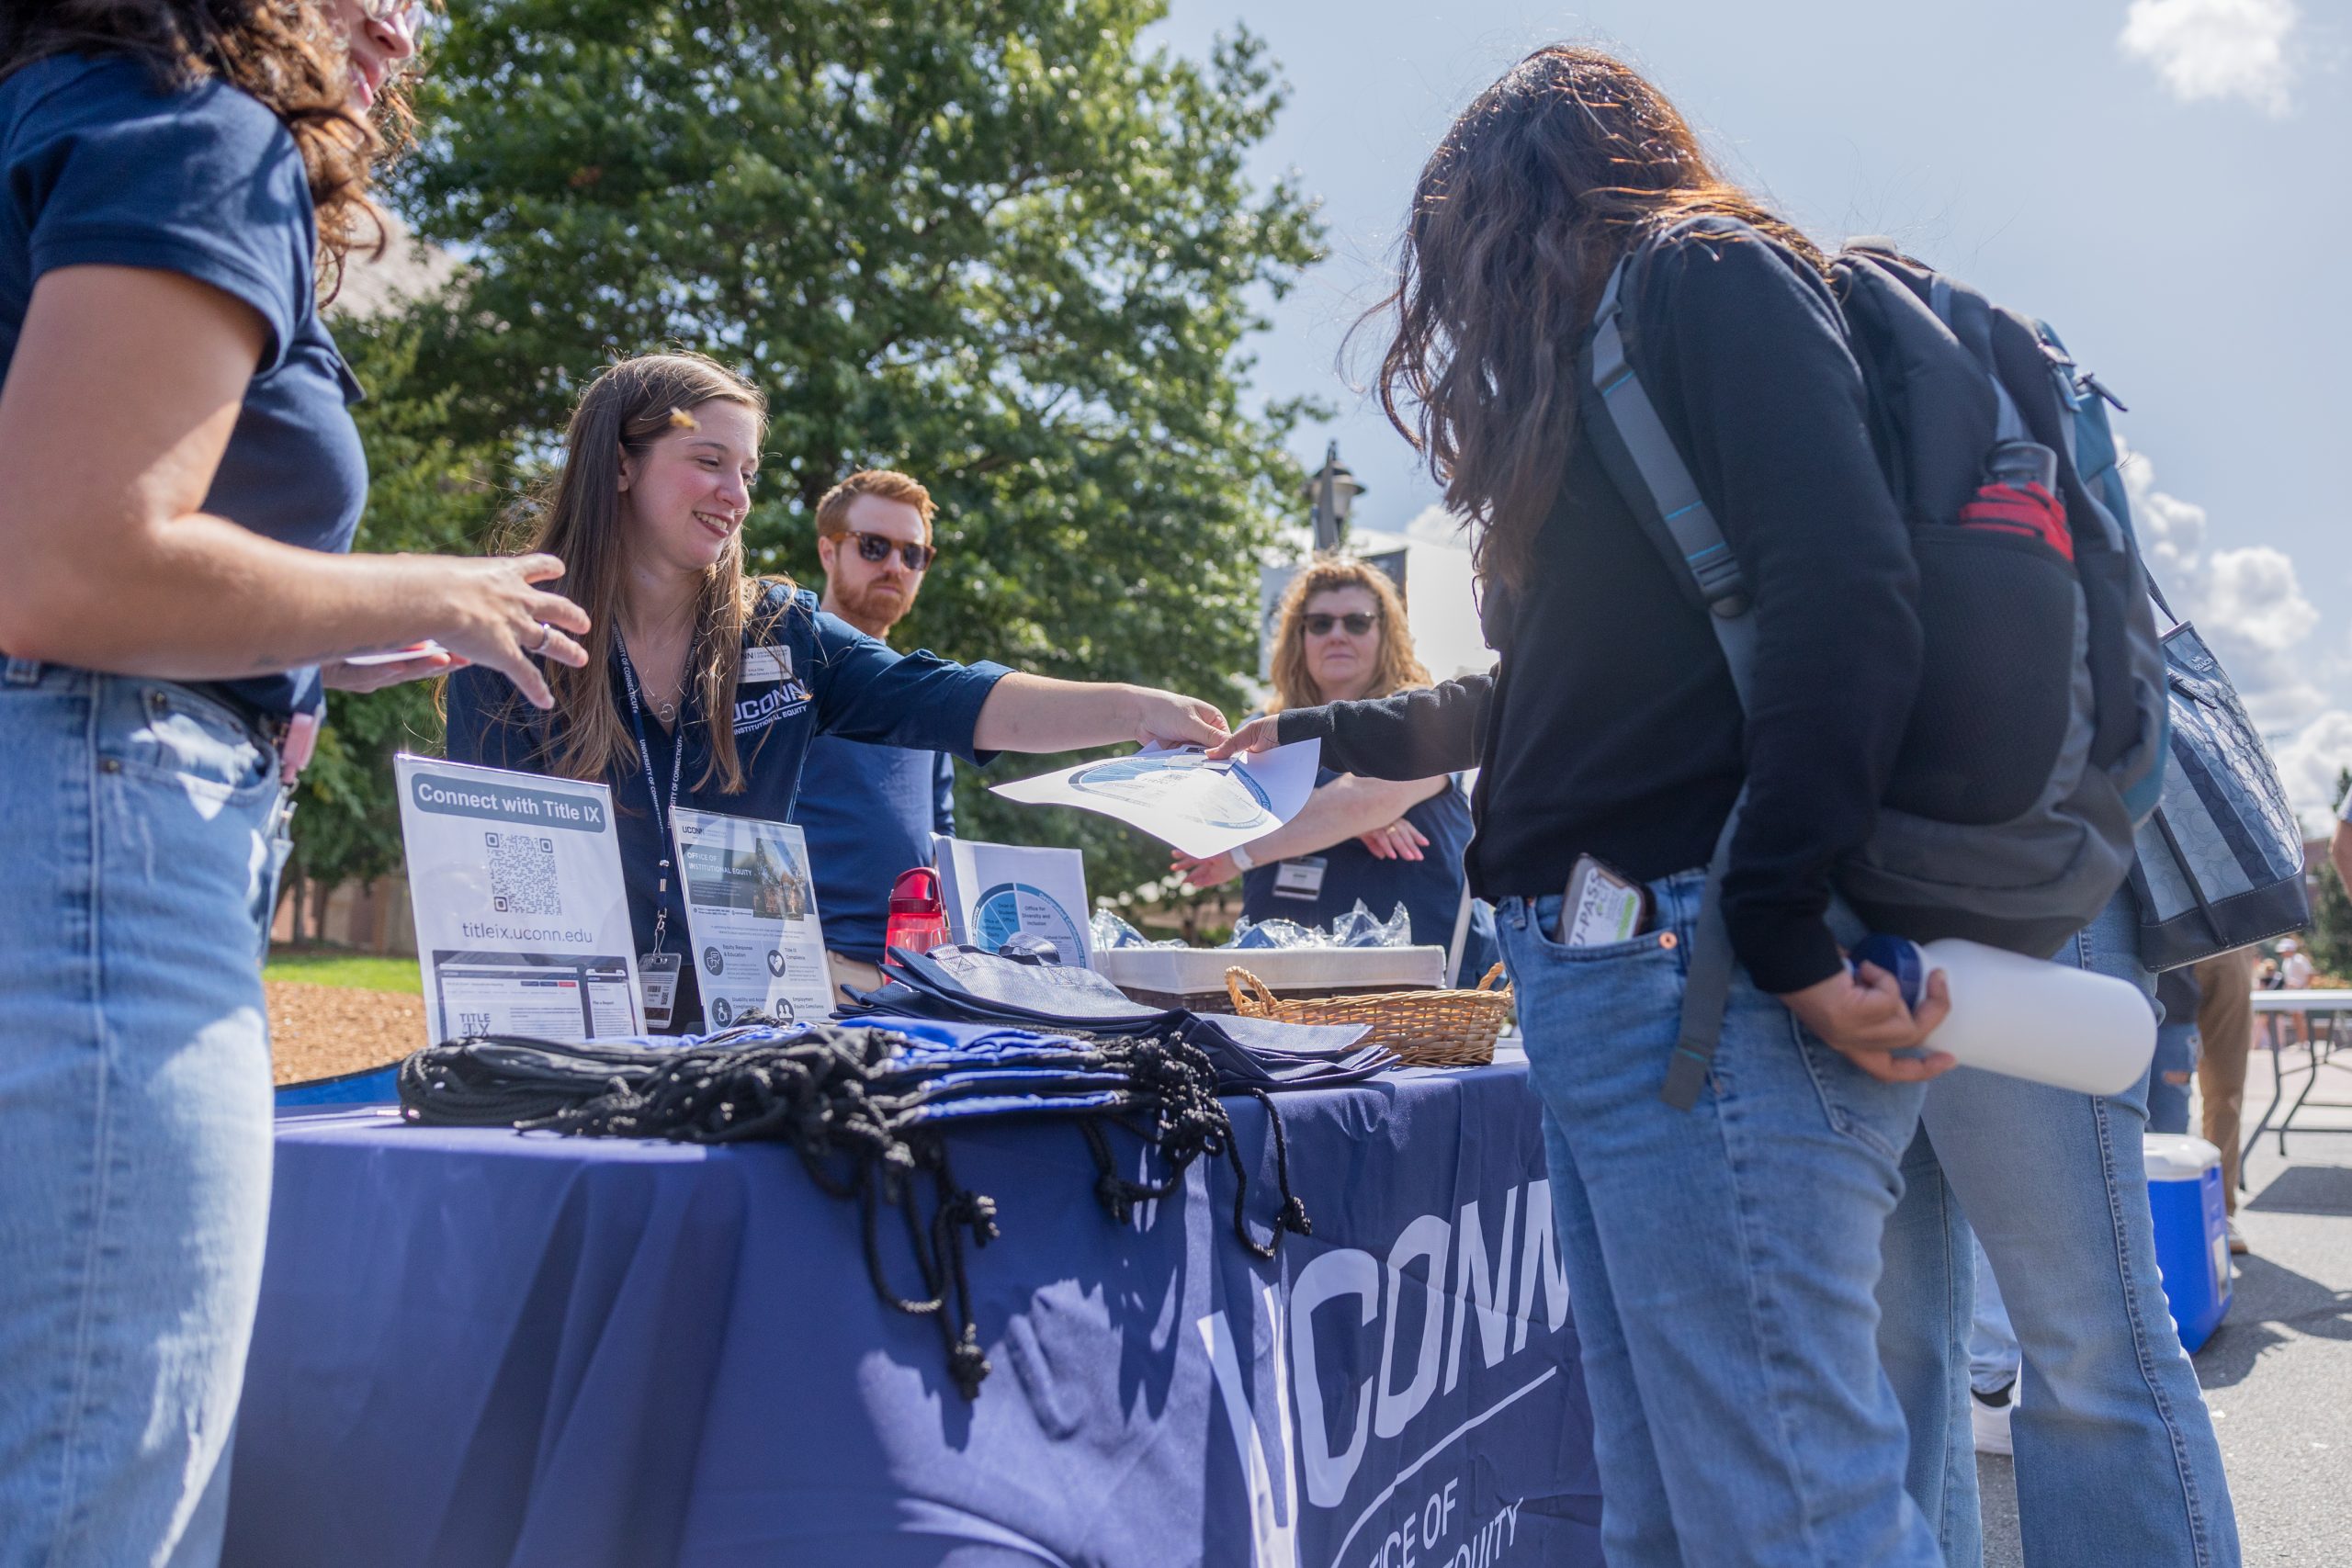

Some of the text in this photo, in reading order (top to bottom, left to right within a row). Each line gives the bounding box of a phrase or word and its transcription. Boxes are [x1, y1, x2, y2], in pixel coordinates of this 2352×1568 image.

[622, 656, 628, 665] OF
[733, 705, 808, 735] INSTITUTIONAL EQUITY
[639, 739, 653, 776] UNIVERSITY
[649, 776, 655, 785] OF
[673, 738, 684, 782] CONNECTICUT
[672, 782, 679, 791] OF
[418, 784, 601, 823] Connect with Title IX
[687, 852, 707, 861] OFFICE
[689, 863, 752, 876] INSTITUTIONAL EQUITY
[463, 922, 593, 943] titleix.uconn.edu
[459, 1013, 491, 1023] TITLE
[1423, 1477, 1458, 1551] OF
